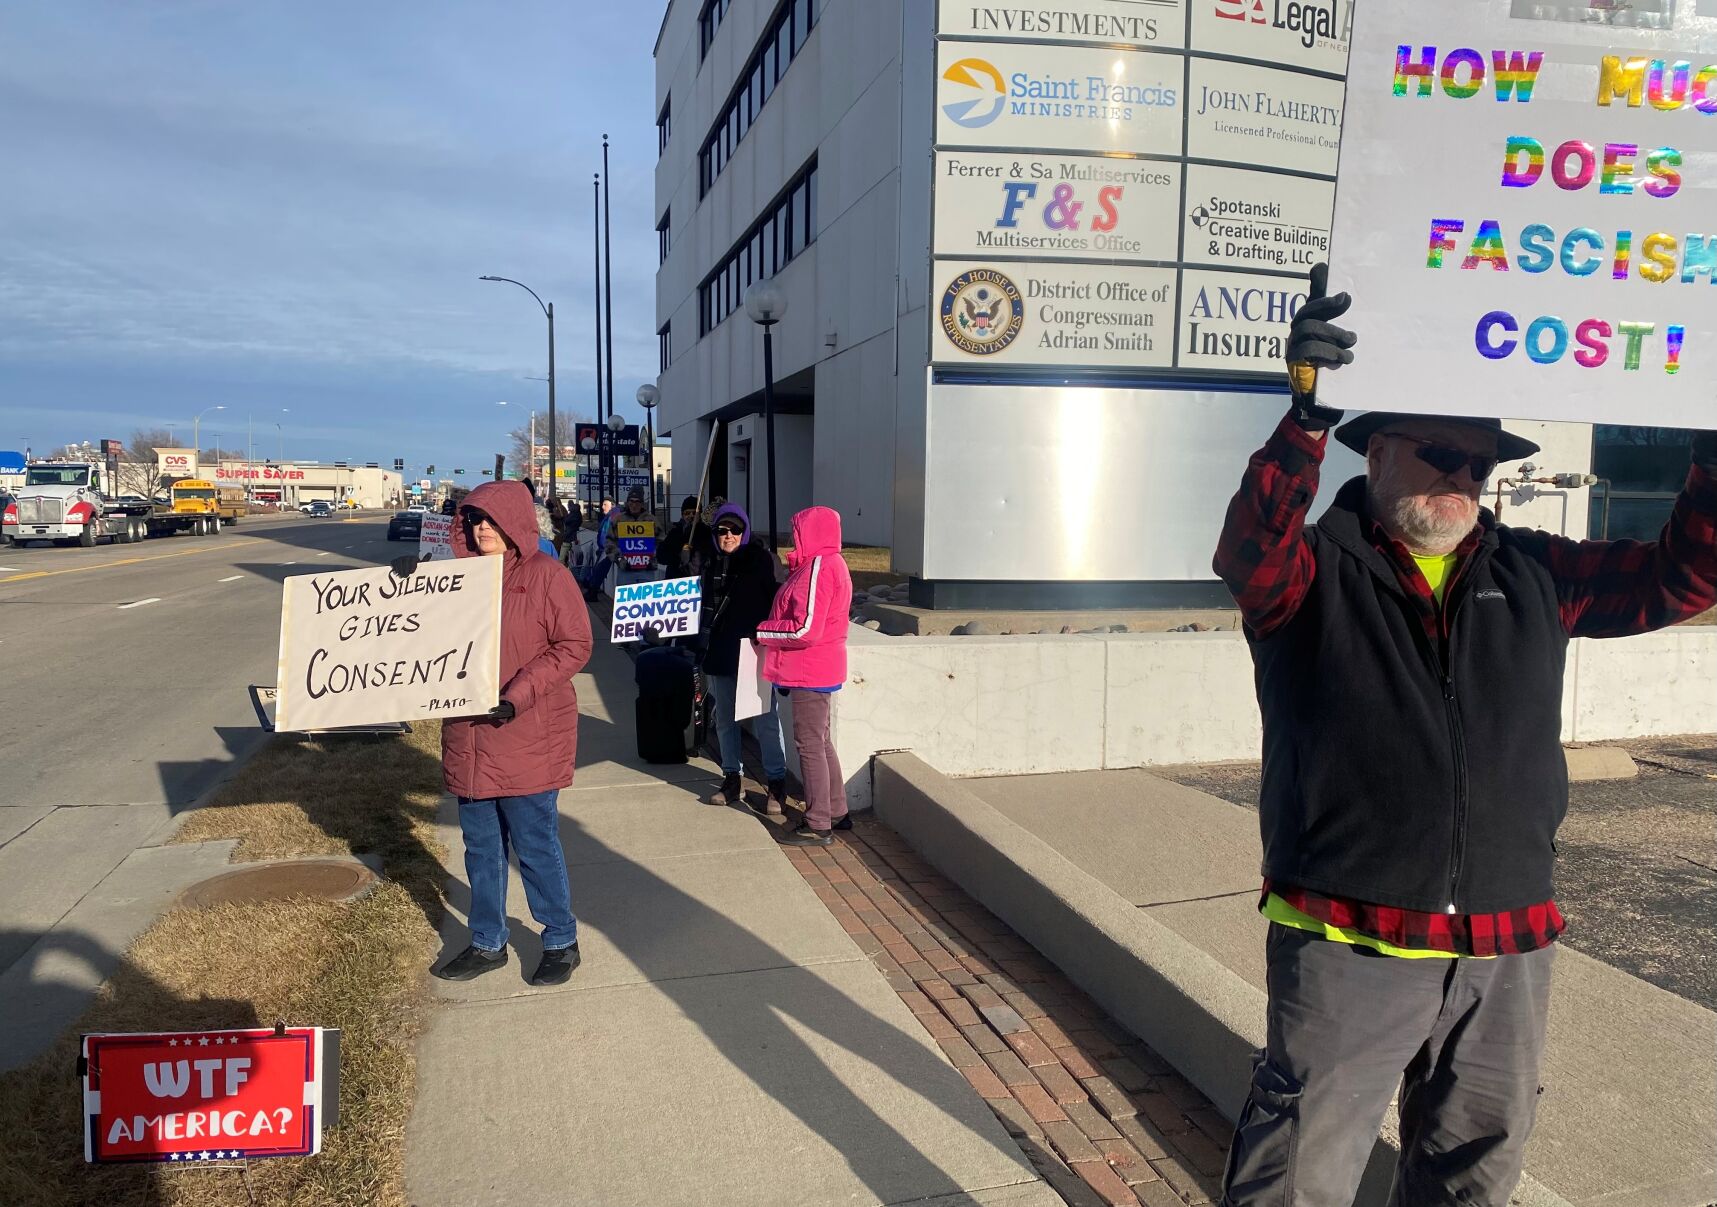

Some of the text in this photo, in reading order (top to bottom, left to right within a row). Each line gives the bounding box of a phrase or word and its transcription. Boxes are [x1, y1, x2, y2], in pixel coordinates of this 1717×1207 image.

[970, 8, 1158, 41] INVESTMENTS
[1272, 0, 1337, 48] Legal
[1392, 45, 1545, 103] HOW
[1011, 73, 1176, 107] Saint Francis
[1197, 86, 1250, 115] JOHN
[1010, 102, 1133, 120] MINISTRIES
[1215, 121, 1264, 137] Licensened
[1266, 127, 1316, 145] Professional
[947, 160, 1171, 185] Ferrer & Sa Multiservices
[1501, 136, 1683, 198] DOES
[994, 181, 1124, 232] F & S
[1210, 197, 1281, 218] Spotanski
[976, 230, 1141, 252] Multiservices Office
[1209, 221, 1327, 251] Creative Building
[1208, 240, 1314, 265] & Drafting, LLC
[1426, 218, 1717, 285] FASCISM
[948, 270, 1020, 301] U.S. HOUSE OF
[1027, 279, 1169, 302] District Office of
[1039, 305, 1154, 329] Congressman
[943, 314, 1022, 353] REPRESENTATIVES
[1038, 329, 1153, 351] Adrian Smith
[1187, 322, 1289, 360] Insura
[1475, 310, 1686, 375] COST!
[165, 456, 187, 465] CVS
[215, 468, 305, 480] SUPER SAVER
[581, 475, 600, 483] Prme
[625, 476, 648, 486] Space
[626, 525, 645, 535] NO
[625, 540, 648, 550] U.S.
[624, 555, 650, 565] WAR
[311, 570, 465, 614] YOUR SILENCE
[616, 579, 700, 603] IMPEACH
[615, 597, 702, 620] CONVICT
[339, 613, 421, 641] GIVES
[613, 617, 688, 638] REMOVE
[306, 641, 474, 699] CONSENT!
[143, 1057, 251, 1099] WTF
[107, 1107, 293, 1144] AMERICA?
